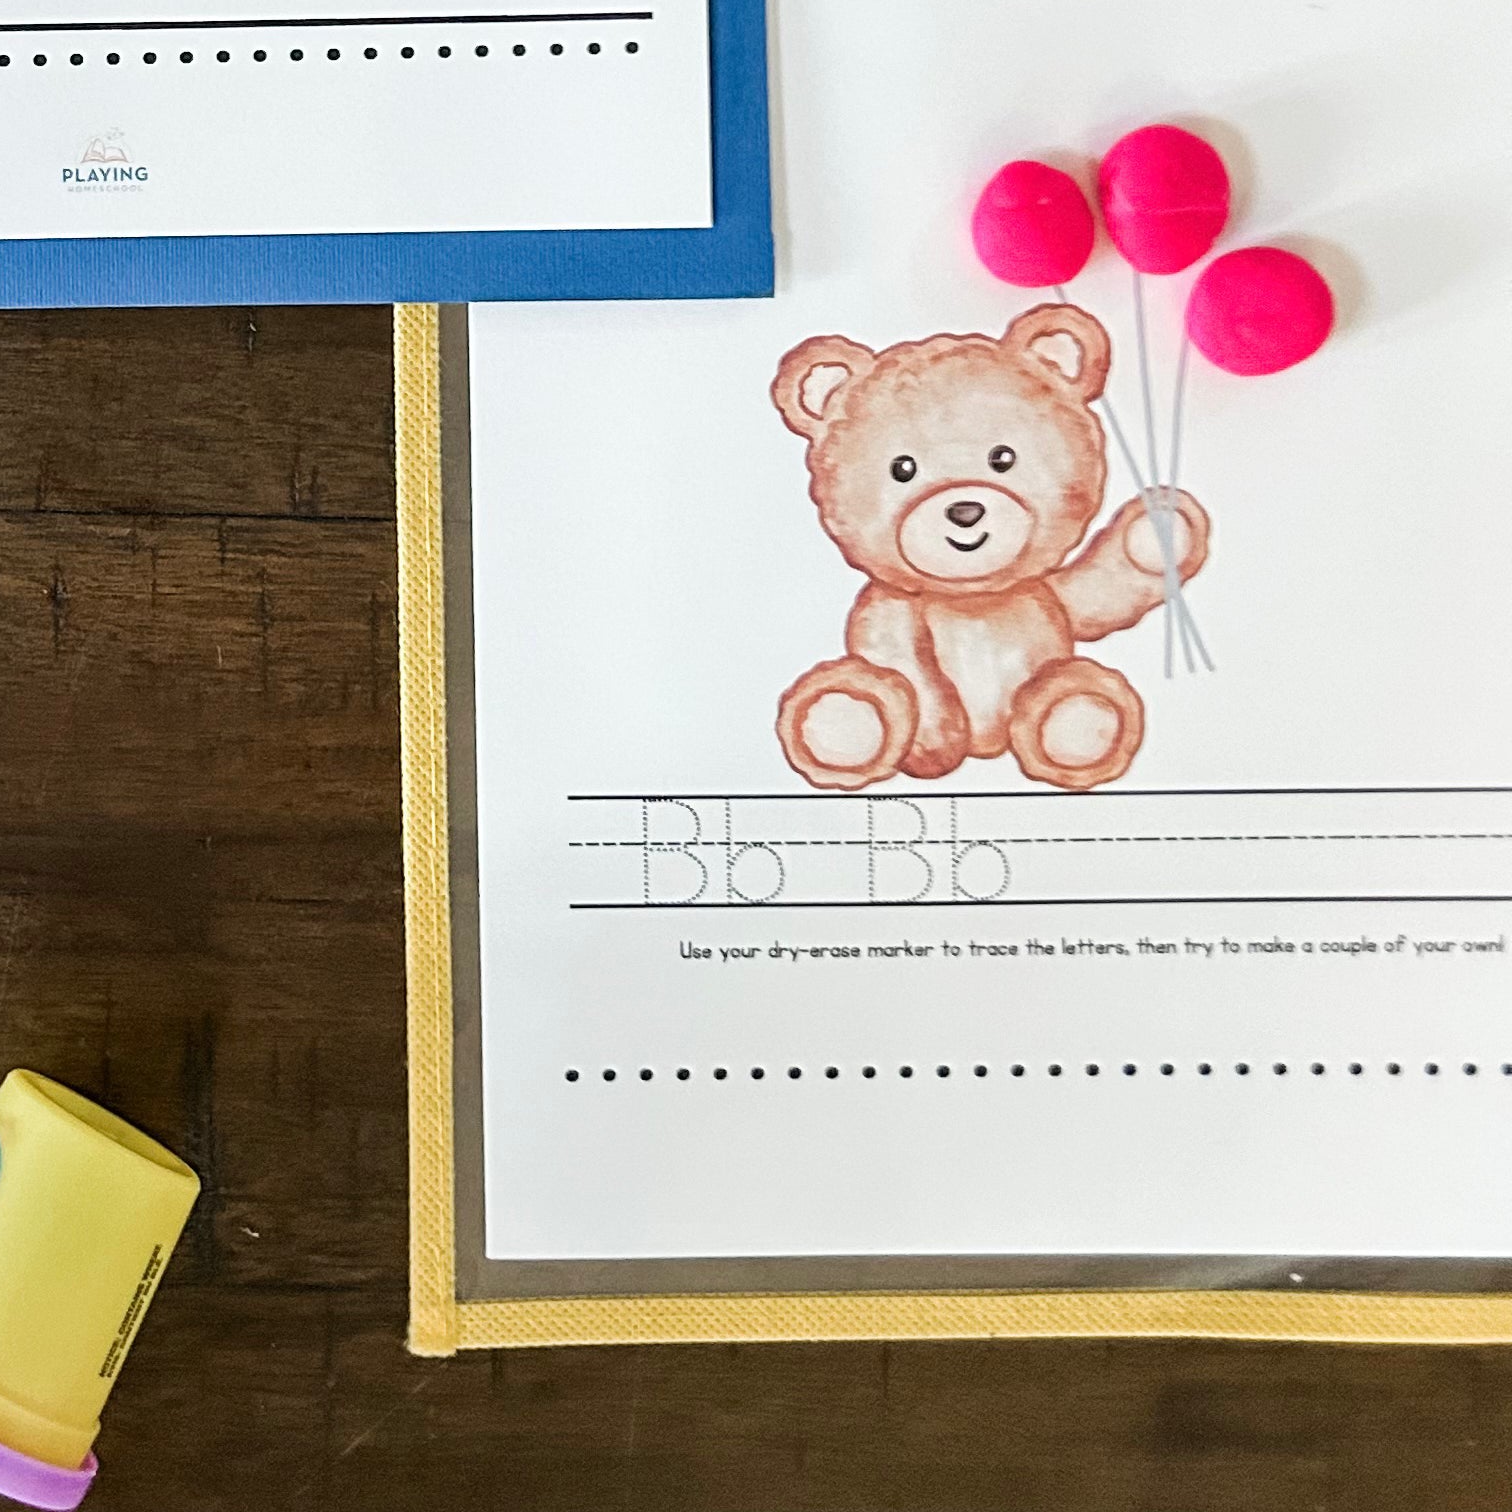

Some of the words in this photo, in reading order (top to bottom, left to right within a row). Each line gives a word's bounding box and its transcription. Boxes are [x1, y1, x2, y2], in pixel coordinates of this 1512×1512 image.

[62, 166, 149, 183] PLAYING
[679, 940, 713, 960] Use
[719, 946, 762, 963] your
[768, 940, 861, 963] dry-erase
[867, 939, 935, 958] marker
[940, 939, 962, 957] to
[968, 939, 1019, 957] trace
[1025, 938, 1056, 956] the
[1061, 936, 1130, 956] letters,
[1136, 936, 1178, 954] then
[1184, 937, 1214, 958] try
[1220, 936, 1241, 954] to
[1247, 935, 1296, 953] make
[1301, 942, 1314, 954] a
[1320, 934, 1378, 956] couple
[1384, 933, 1408, 953] of
[1413, 940, 1458, 957] your
